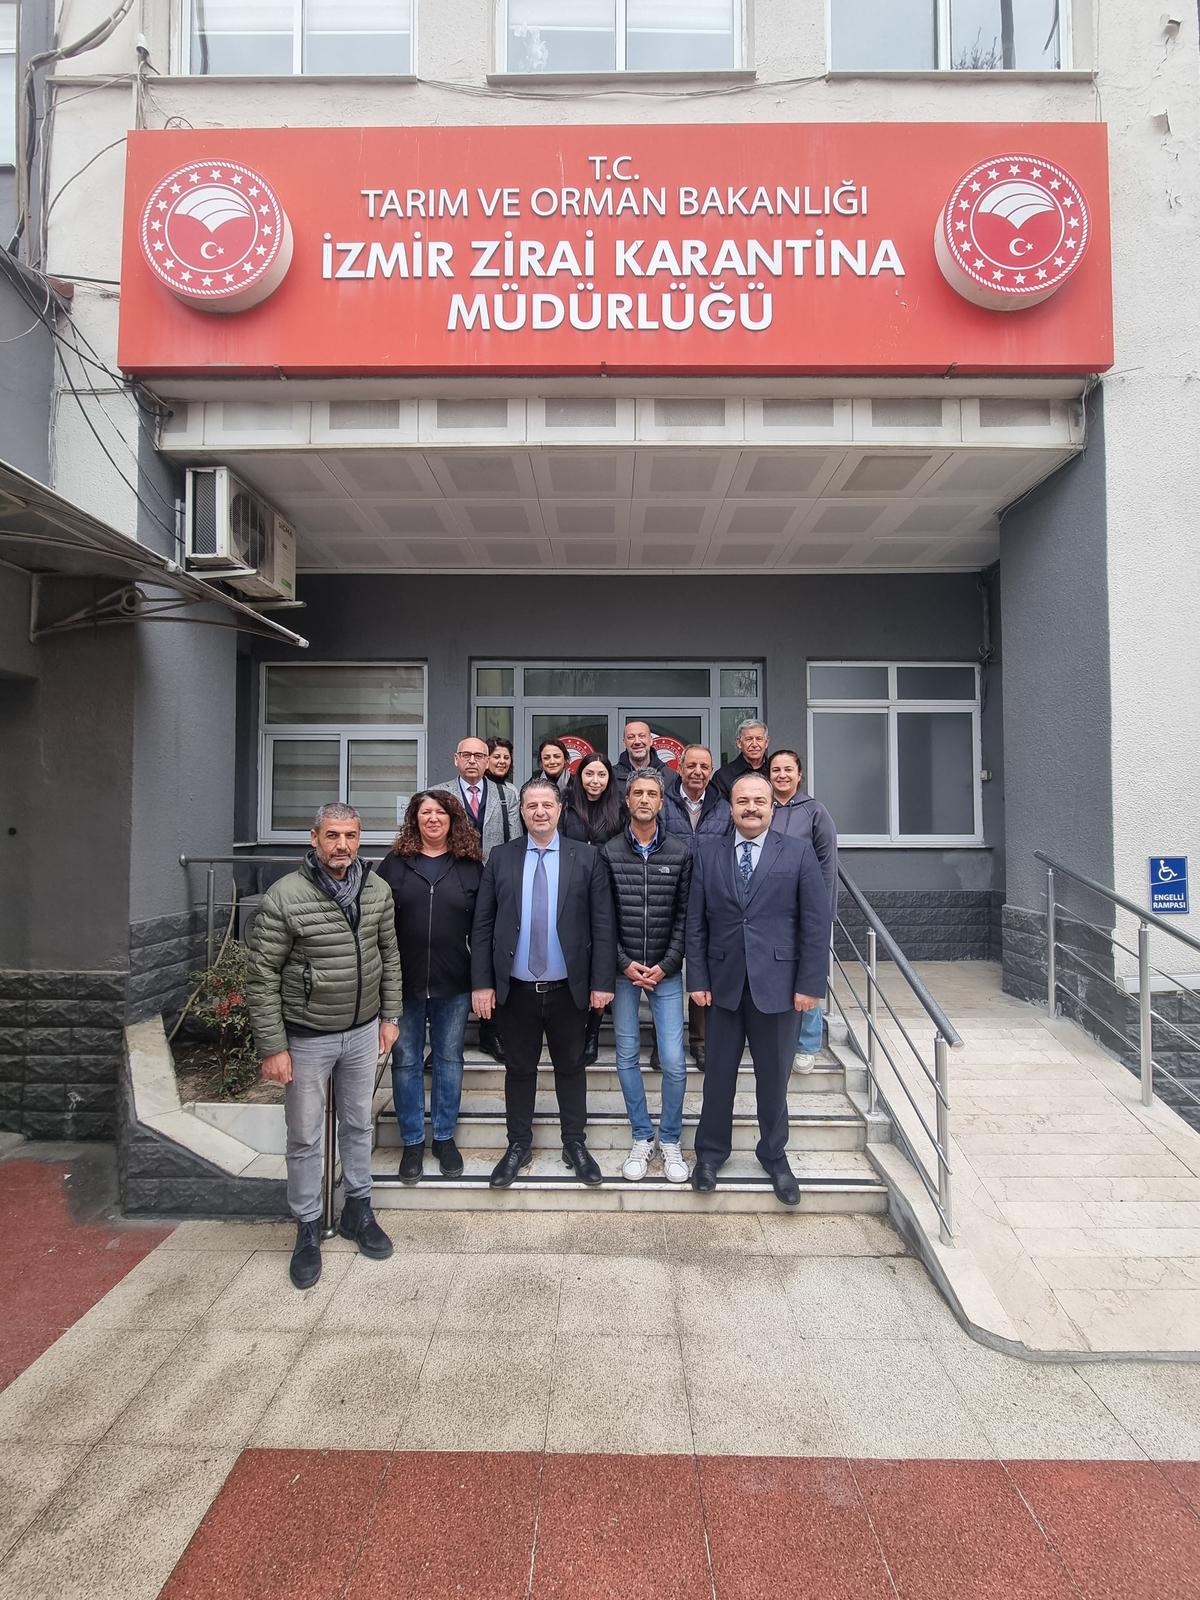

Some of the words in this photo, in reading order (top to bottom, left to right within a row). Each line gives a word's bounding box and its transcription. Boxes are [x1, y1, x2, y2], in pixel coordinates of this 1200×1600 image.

[588, 155, 640, 182] T.C.
[360, 189, 470, 219] TARIM
[477, 187, 521, 218] VE
[530, 186, 667, 217] ORMAN
[679, 179, 869, 217] BAKANLIĞI
[322, 230, 455, 280] İZMİR
[469, 229, 596, 279] ZİRAİ
[614, 229, 906, 278] KARANTİNA
[446, 281, 774, 332] MÜDÜRLÜĞÜ
[1153, 892, 1184, 901] ENGELLİ
[1153, 901, 1185, 909] RAMPASI
